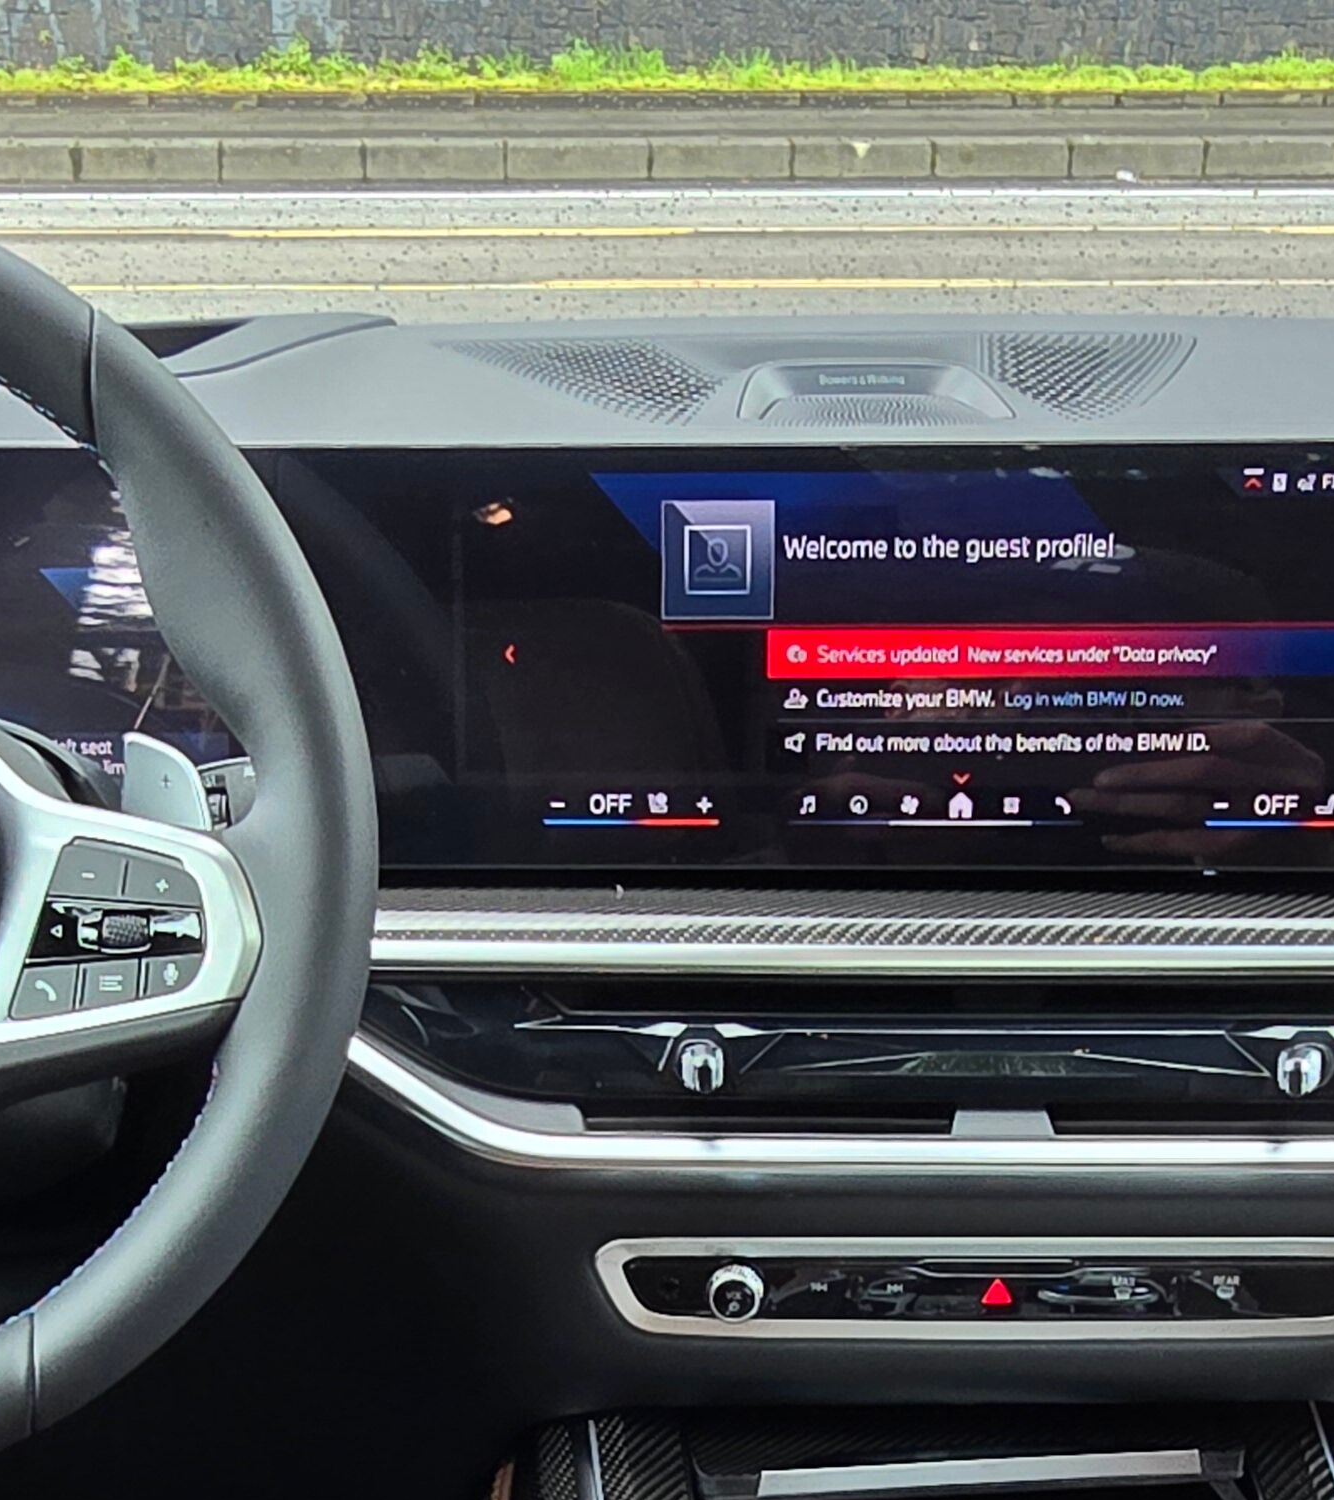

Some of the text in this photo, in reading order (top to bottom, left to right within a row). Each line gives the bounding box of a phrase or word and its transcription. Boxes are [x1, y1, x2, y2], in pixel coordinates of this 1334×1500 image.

[783, 532, 1115, 563] Welcome to the guest profile!
[817, 645, 886, 664] Services
[890, 645, 959, 666] updated
[968, 646, 1001, 663] New
[1004, 645, 1063, 663] services
[1067, 645, 1110, 663] under
[817, 688, 1184, 711] Customize your BMW. Log in with BMW ID now.
[80, 740, 113, 755] seat
[816, 733, 1210, 752] Find out more about the benefits of the BMW ID.
[589, 793, 632, 815] OFF
[1254, 793, 1299, 816] OFF
